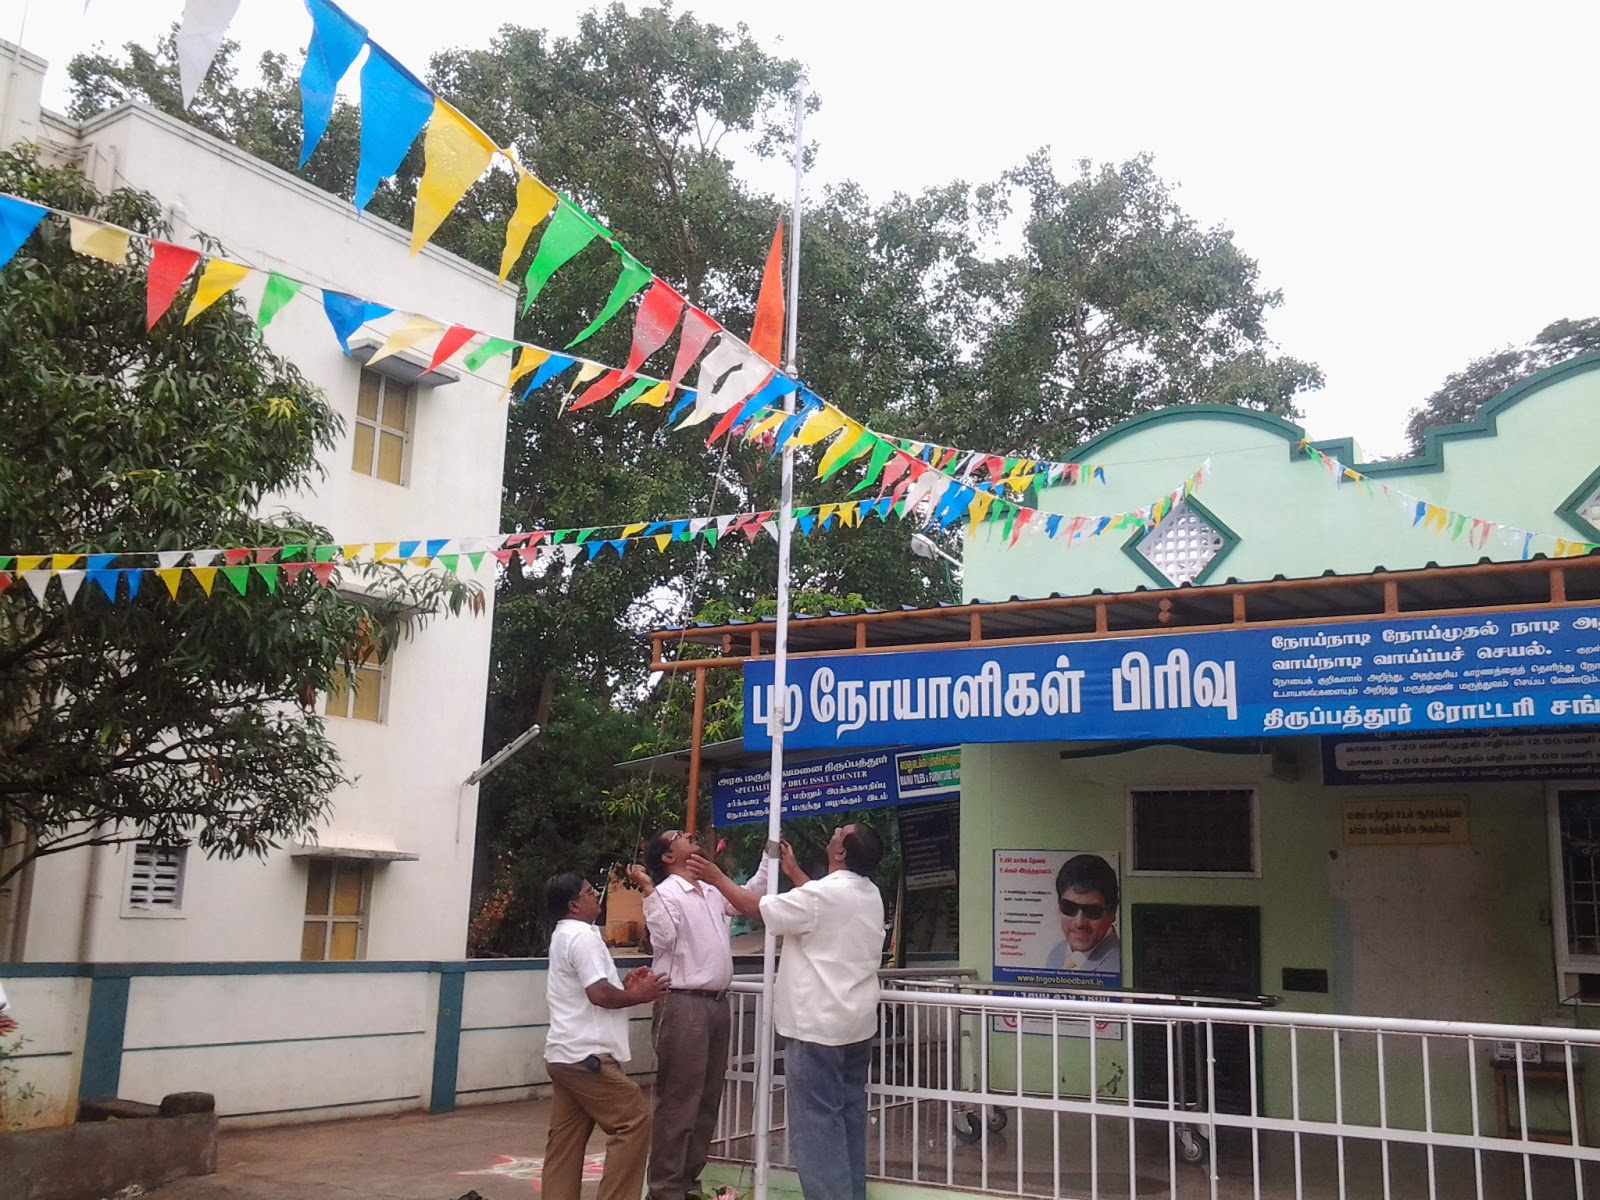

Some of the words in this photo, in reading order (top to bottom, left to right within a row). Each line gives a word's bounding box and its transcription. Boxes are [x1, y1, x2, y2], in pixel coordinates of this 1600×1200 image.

[1271, 631, 1371, 651] நோய்நாடி
[1382, 620, 1499, 643] நோய்முதல்
[1510, 619, 1560, 637] நாடி
[1272, 654, 1363, 673] வாய்நாடி
[1373, 646, 1465, 667] வாய்ப்பச்
[1112, 648, 1238, 721] பிரிவு
[1263, 704, 1412, 732] திருப்பத்தூர்
[1427, 697, 1534, 724] ரோட்டரி
[1527, 737, 1560, 746] 12.00
[734, 784, 771, 795] SPECIALIT
[788, 777, 809, 788] DRUG
[809, 774, 831, 785] ISSUE
[831, 770, 868, 782] COUNTER
[744, 765, 823, 783] மருத்வமனை
